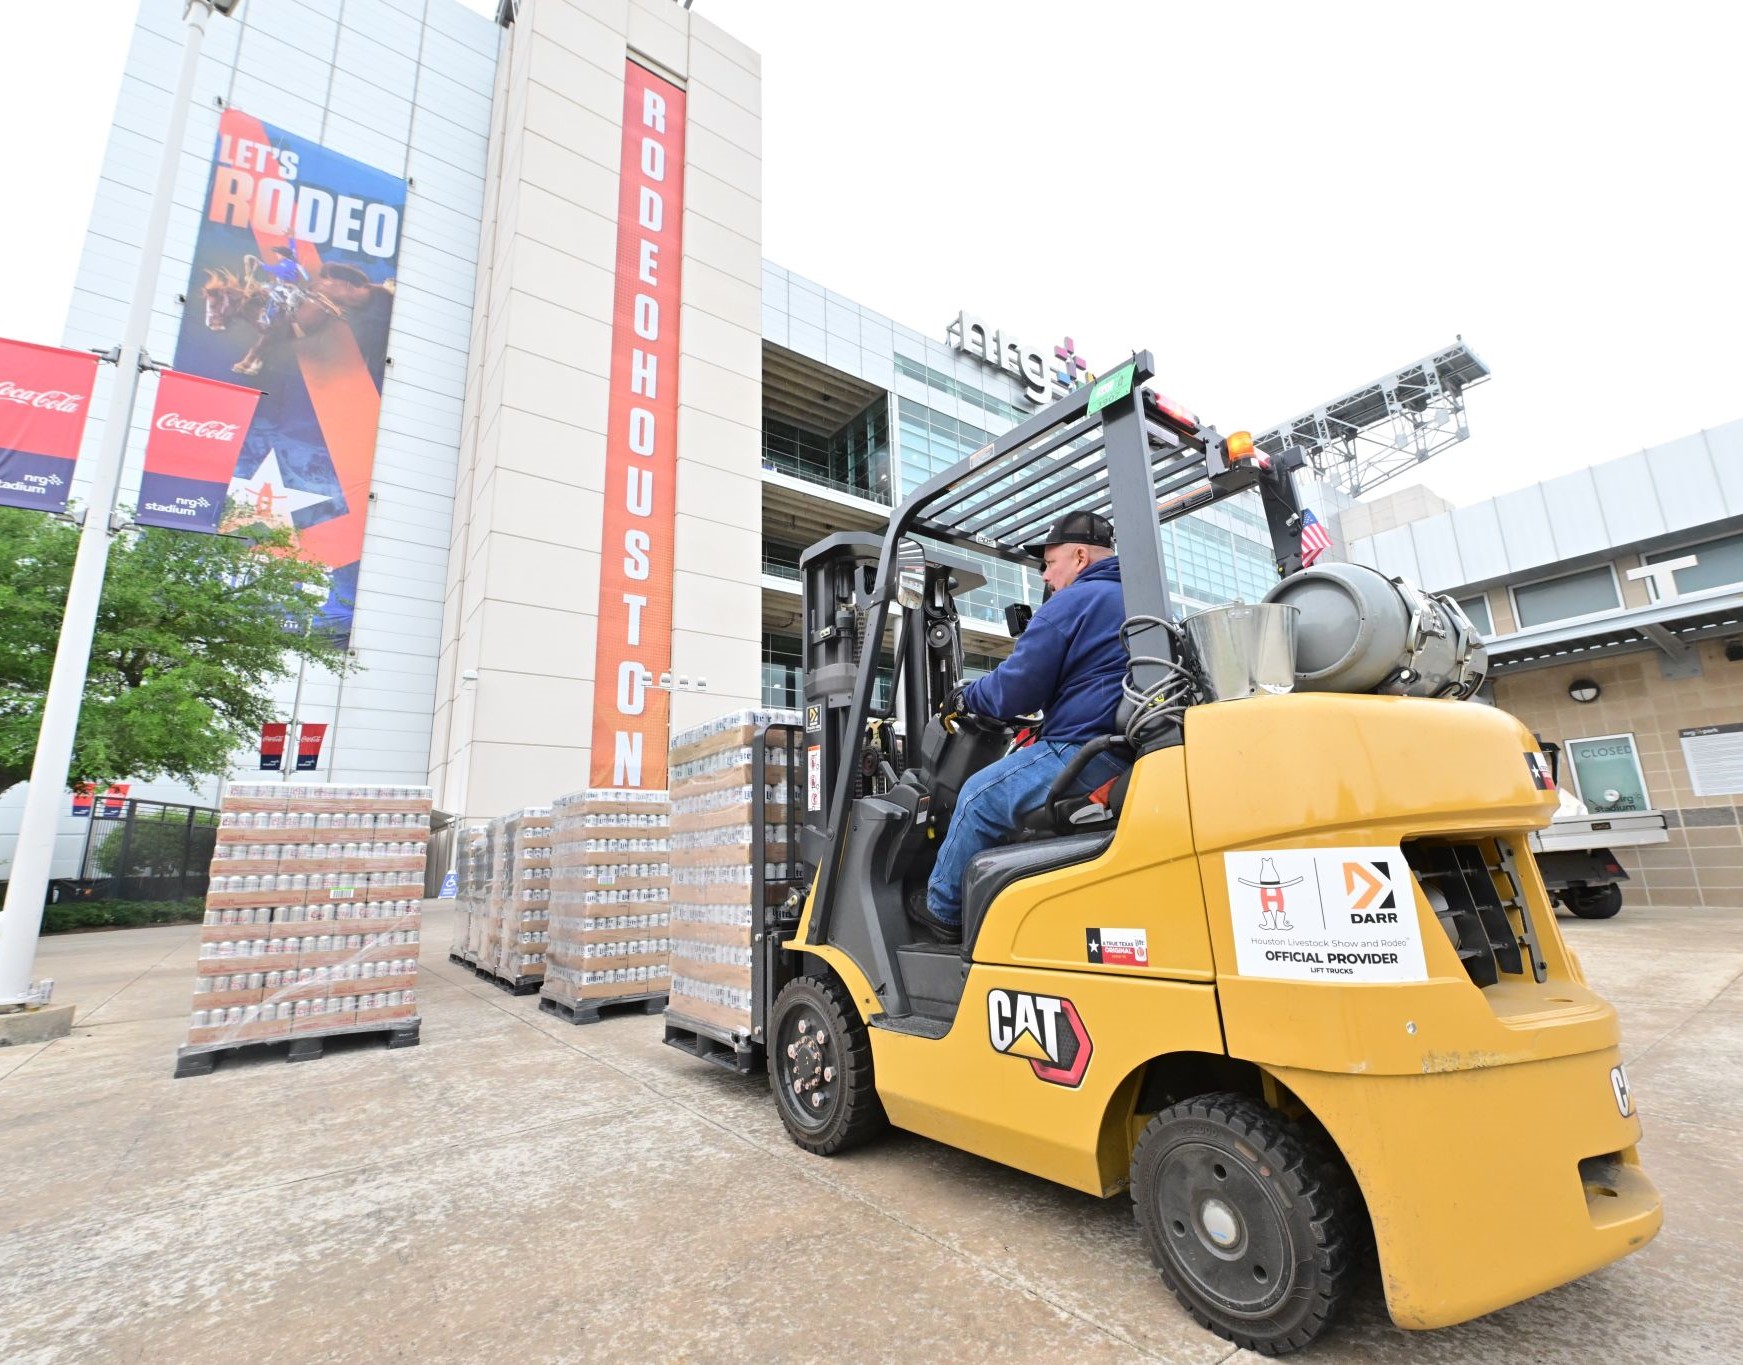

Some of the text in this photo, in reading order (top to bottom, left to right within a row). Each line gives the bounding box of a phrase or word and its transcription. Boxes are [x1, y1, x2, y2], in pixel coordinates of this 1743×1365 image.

[219, 134, 299, 181] LET'S
[208, 165, 399, 259] RODEO
[958, 309, 1052, 406] nrg
[156, 412, 241, 442] Coca-Cola
[0, 479, 46, 494] tadium
[24, 474, 48, 486] nrg
[145, 502, 196, 517] stadium
[176, 496, 198, 509] nrg
[1581, 745, 1632, 759] CLOSED
[1350, 913, 1398, 924] DARR
[1251, 938, 1407, 948] Houston Livestock Show and Rodeo
[1104, 947, 1134, 955] ORIGINAL
[1265, 950, 1399, 965] OFFICIAL PROVIDER
[988, 989, 1062, 1063] CAT
